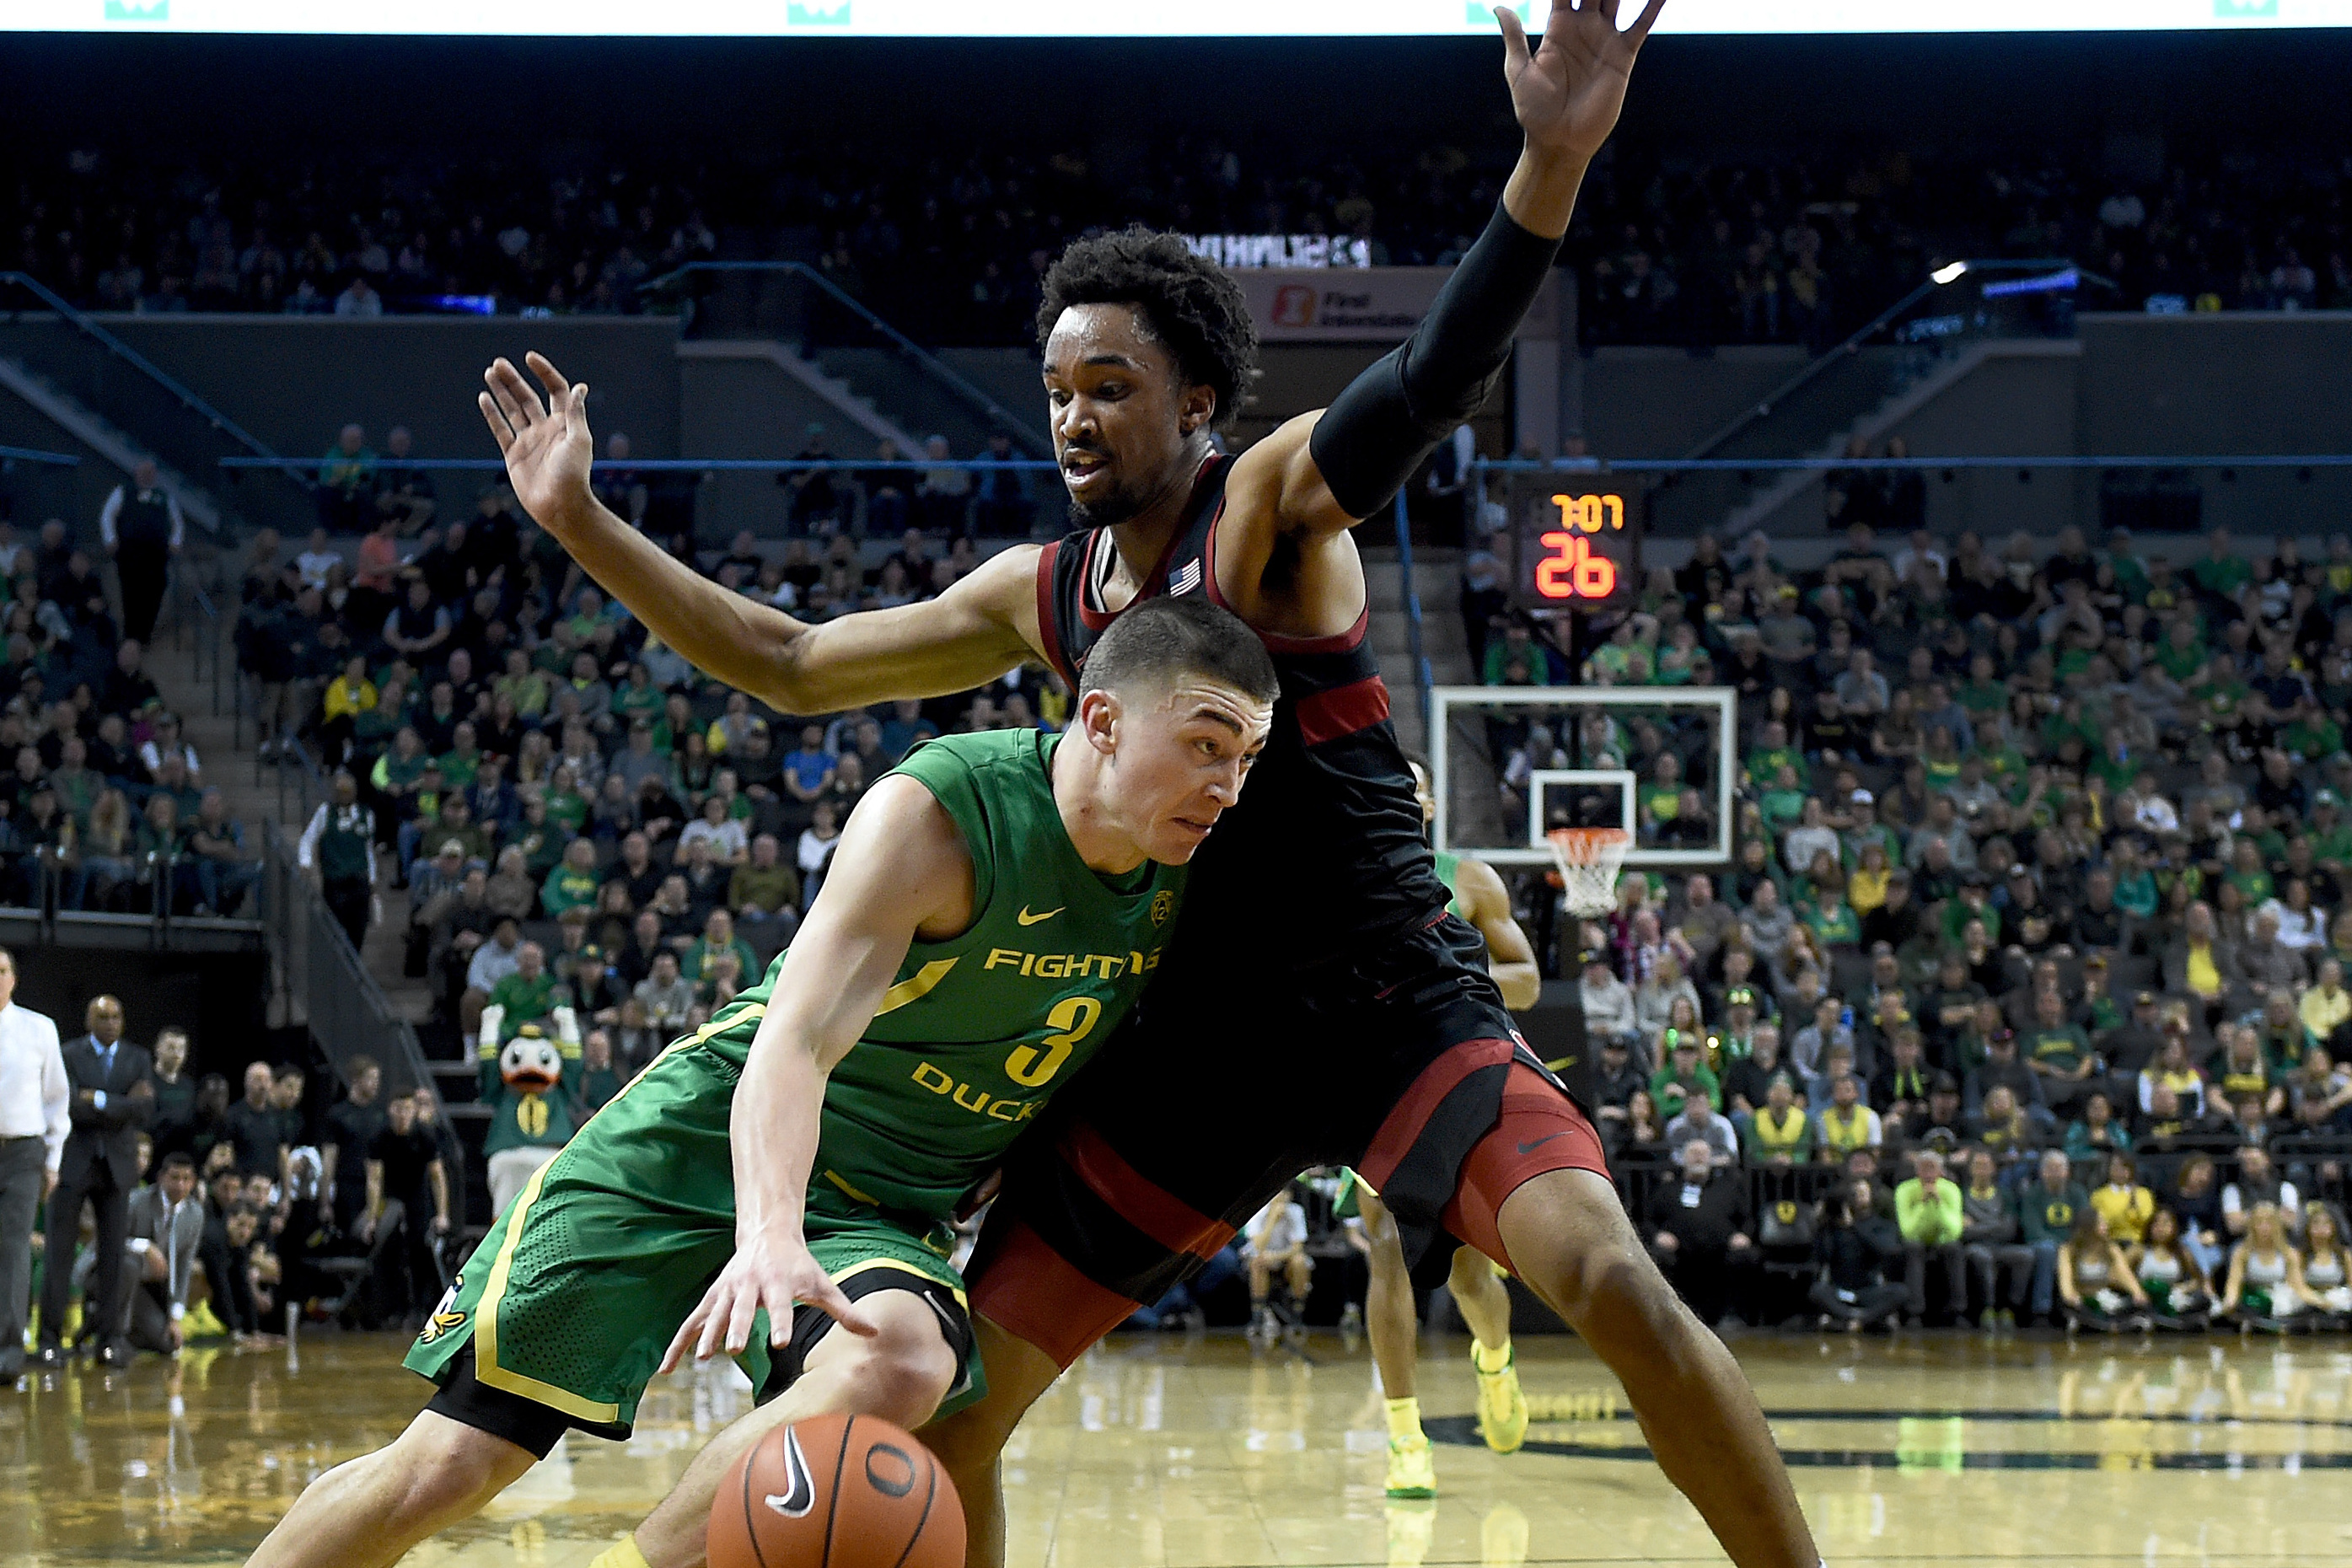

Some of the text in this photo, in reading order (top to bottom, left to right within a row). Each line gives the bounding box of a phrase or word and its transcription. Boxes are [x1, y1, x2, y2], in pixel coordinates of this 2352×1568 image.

[1551, 494, 1624, 533] 7:07
[1536, 532, 1615, 598] 26
[983, 946, 1163, 980] FIGHTG
[1004, 996, 1102, 1087] 3
[910, 1061, 1050, 1123] DUCK
[865, 1442, 916, 1498] O
